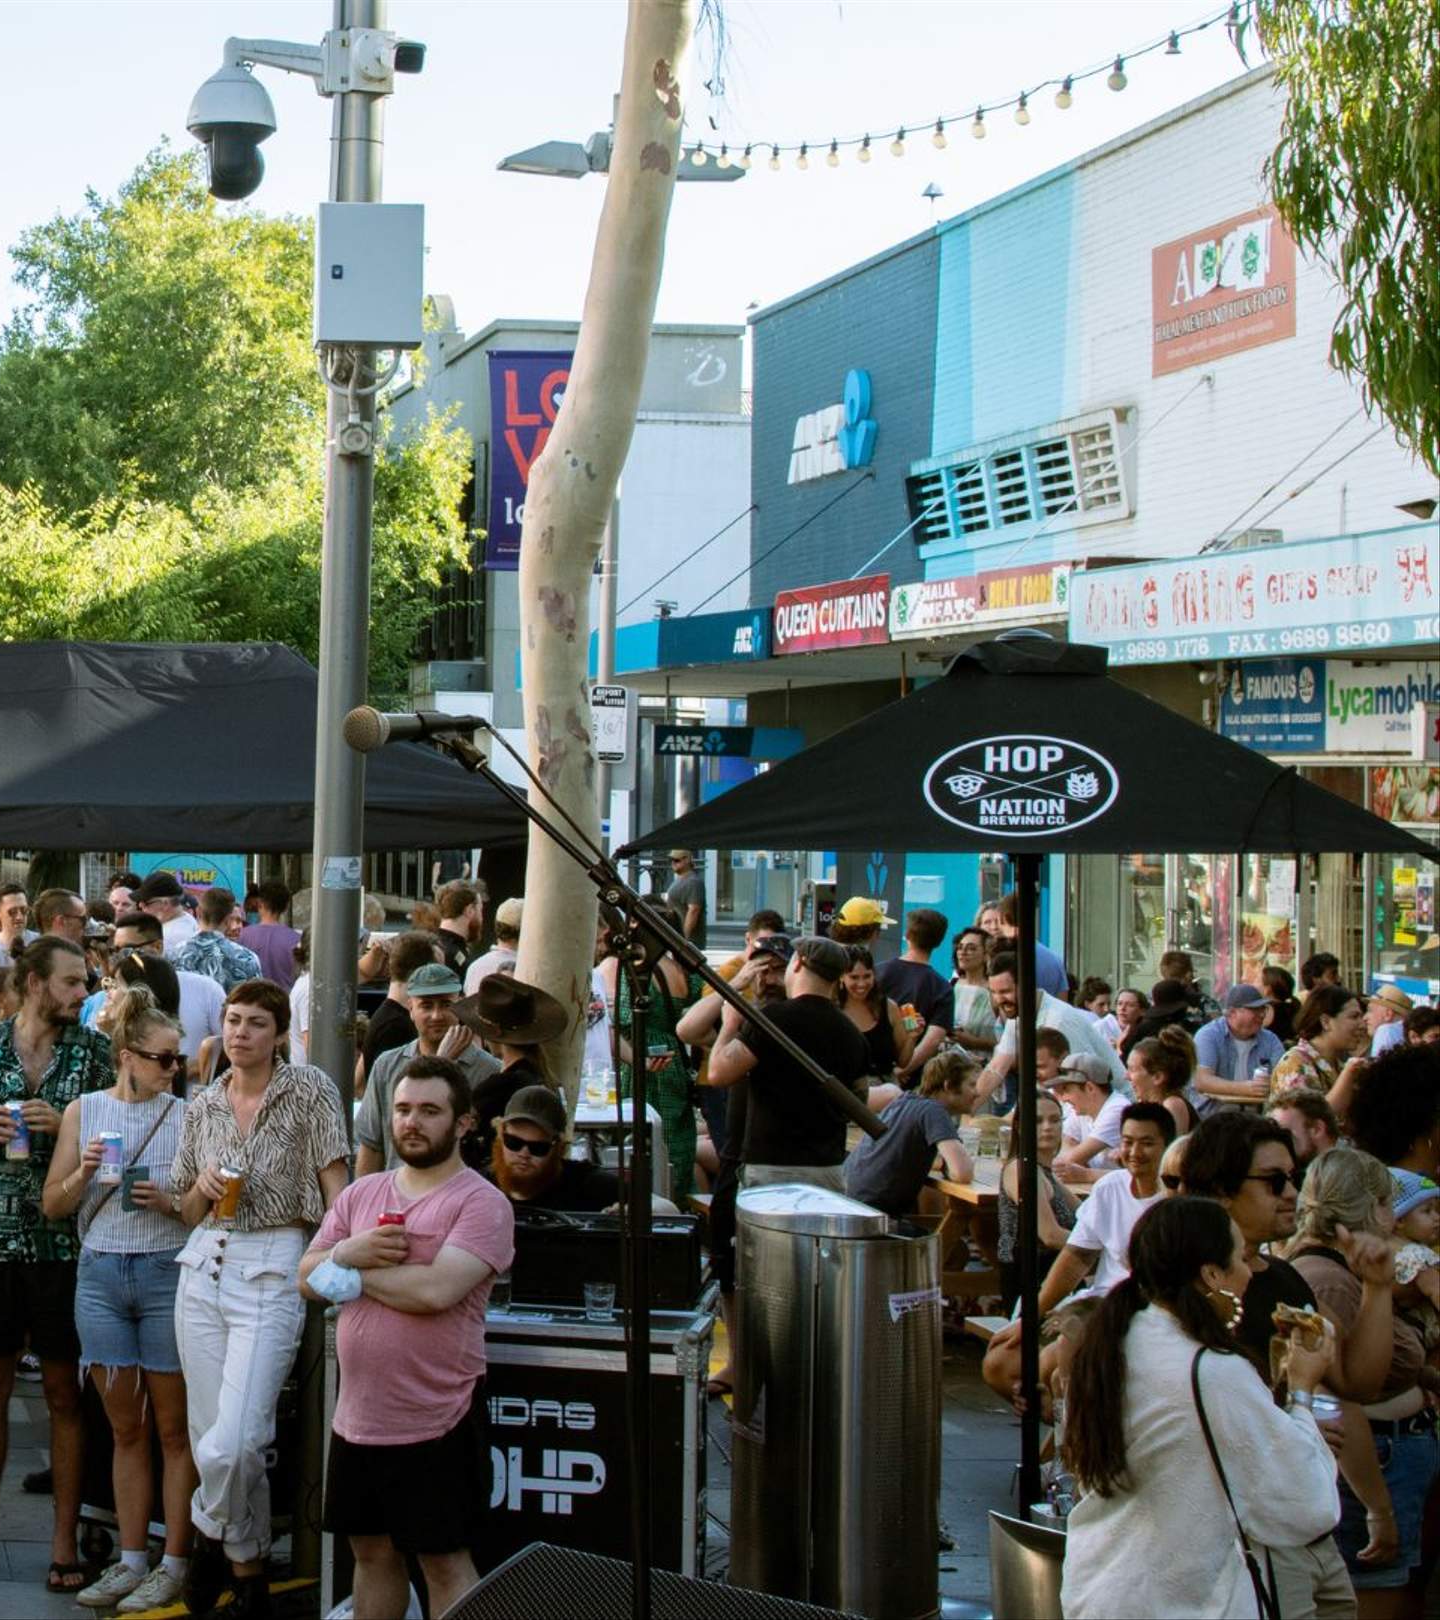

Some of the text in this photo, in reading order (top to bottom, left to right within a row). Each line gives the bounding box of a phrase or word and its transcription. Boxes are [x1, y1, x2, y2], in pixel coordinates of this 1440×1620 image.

[922, 581, 957, 601] HALAL
[989, 578, 1017, 609] BULK
[776, 591, 886, 645] QUEEN CURTAINS
[922, 597, 976, 621] MEATS
[1127, 641, 1167, 661] 9689
[1174, 635, 1209, 658] 1776
[1279, 627, 1330, 650] 9689
[1335, 621, 1391, 647] 8860
[1246, 675, 1298, 700] FAMOUS
[660, 735, 703, 751] ANZ
[984, 745, 1064, 773] HOP
[979, 798, 1066, 815] NATION
[979, 815, 1069, 826] BREWING CO.
